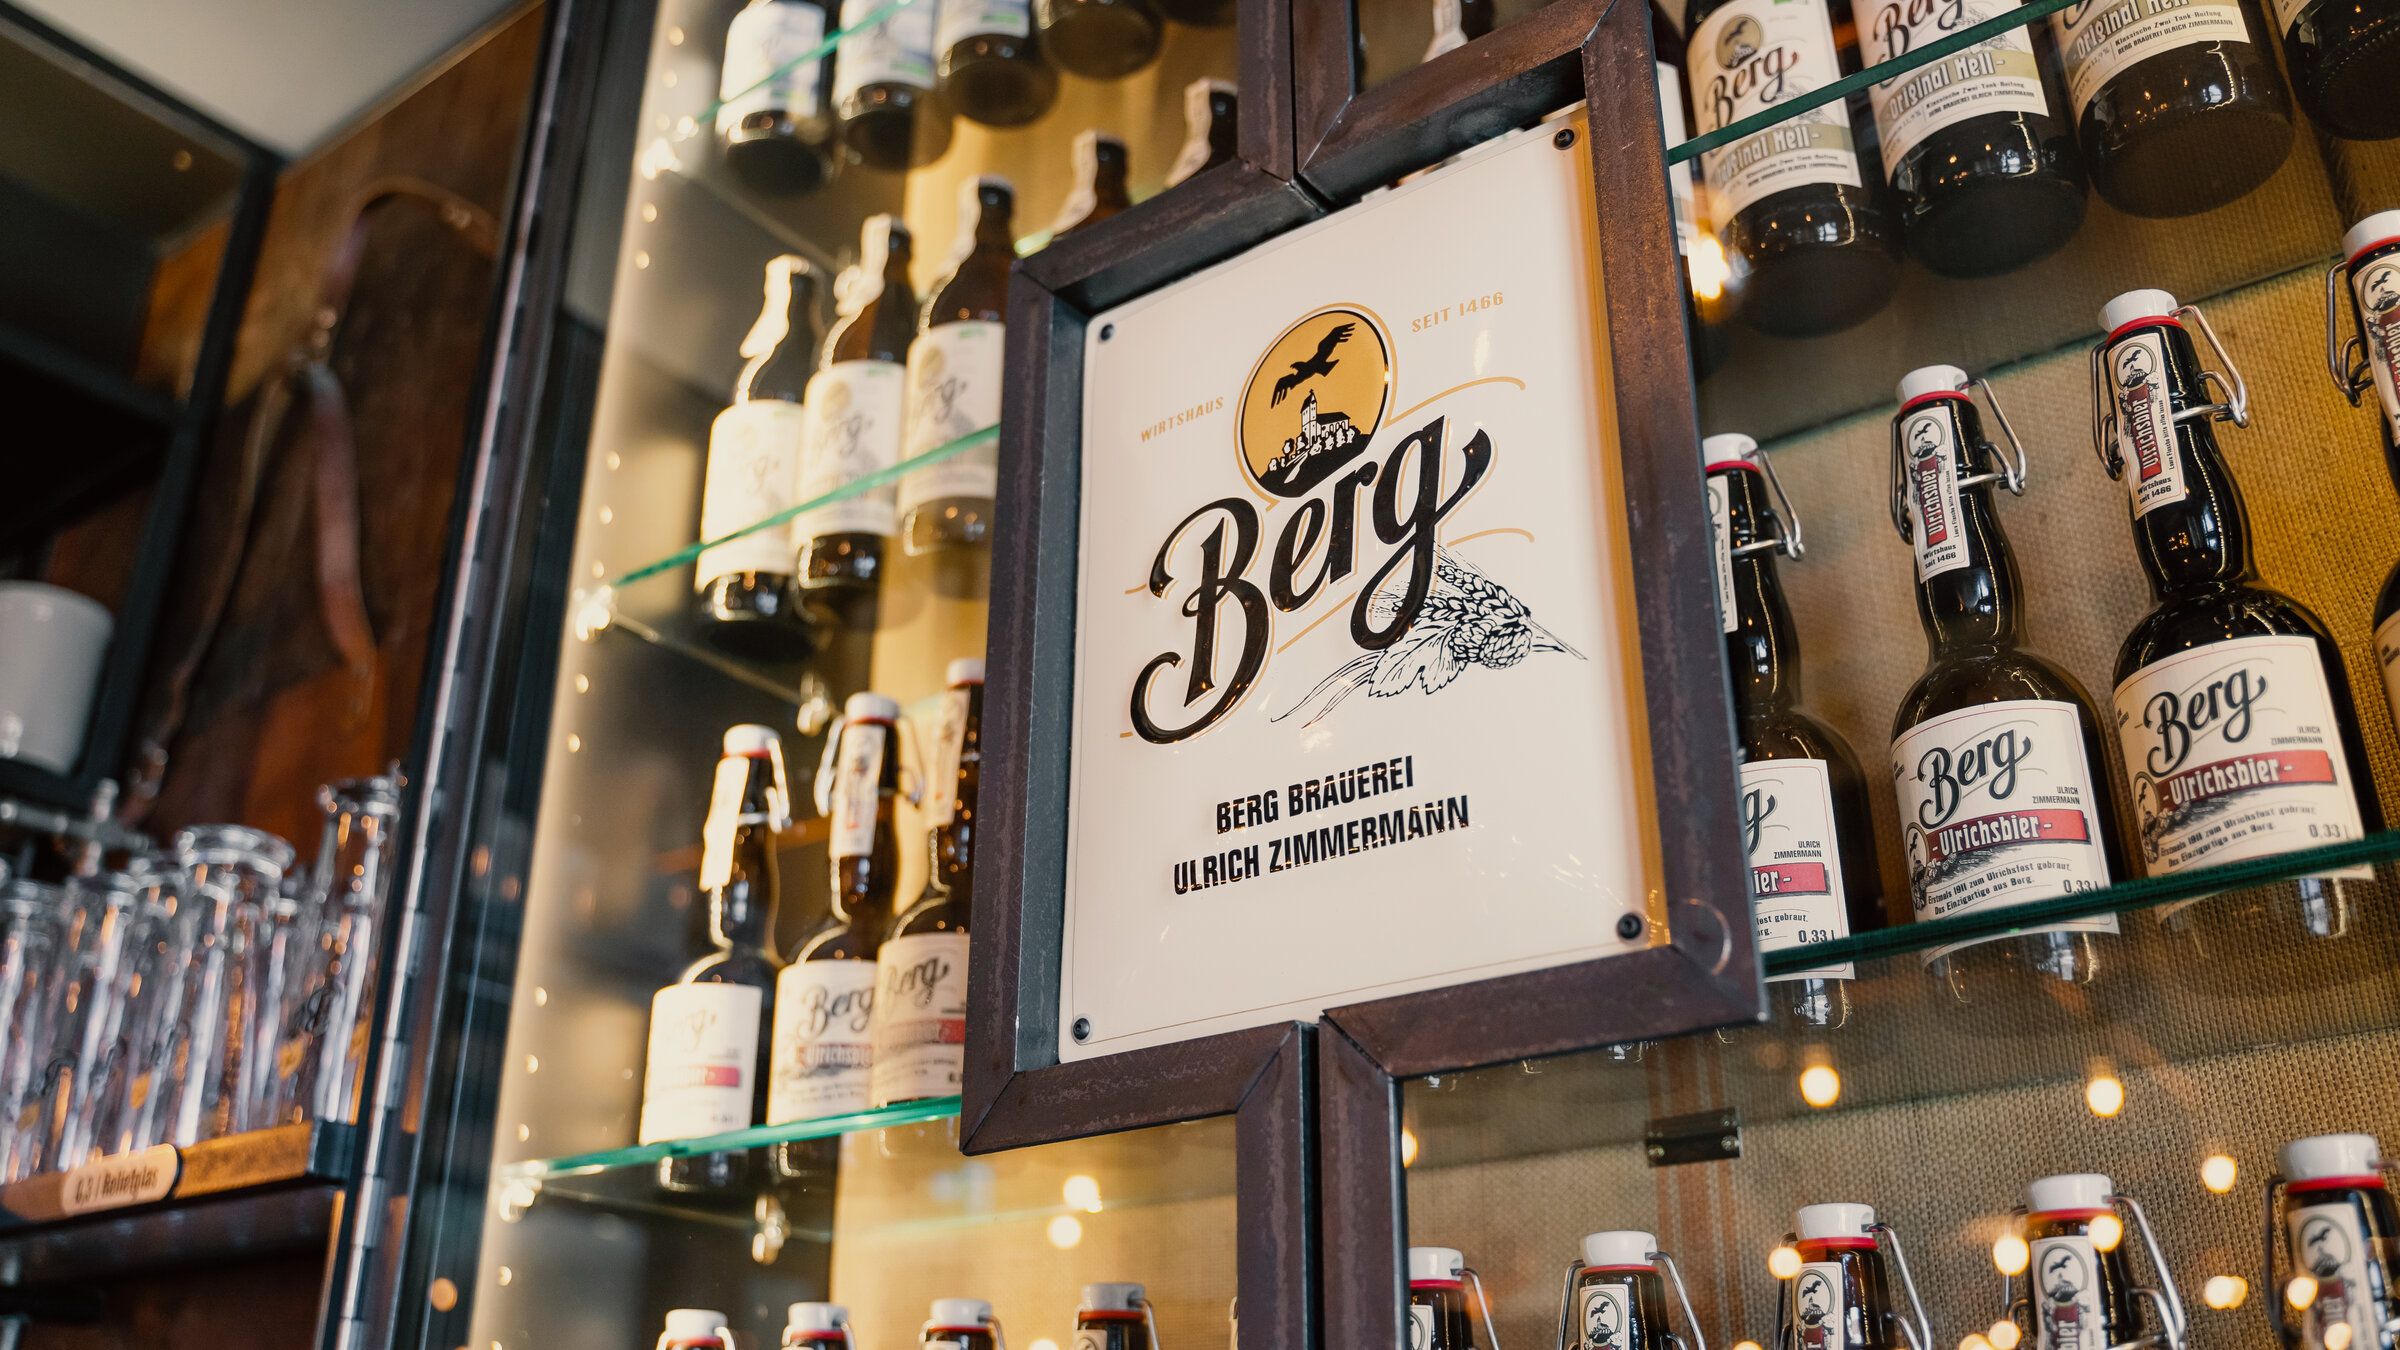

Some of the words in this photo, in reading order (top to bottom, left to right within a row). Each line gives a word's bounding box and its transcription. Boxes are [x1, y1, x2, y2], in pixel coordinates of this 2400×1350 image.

[2133, 30, 2163, 46] BRAUEREI
[2164, 23, 2187, 34] ULRICH
[2188, 19, 2233, 29] ZIMMERMANN
[1704, 46, 1799, 158] Berg
[1411, 307, 1451, 333] SEIT
[1459, 291, 1504, 316] 1466
[1140, 396, 1224, 444] WIRTSHAUS
[2132, 397, 2158, 470] Ulrichsbier
[2137, 477, 2172, 495] Wirtshaus
[1922, 467, 1945, 537] Ulrichsbier
[1923, 545, 1956, 560] Wirtshaus
[1937, 552, 1956, 562] 1466
[1130, 415, 1494, 745] Berg
[2143, 668, 2267, 778] Berg
[2271, 736, 2323, 745] ZIMMERMANN
[1917, 729, 2032, 829] Berg
[2057, 786, 2079, 795] ULRICH
[1217, 790, 1279, 835] BERG
[1288, 755, 1414, 817] BRAUEREI
[2032, 795, 2080, 805] ZIMMERMANN
[1174, 844, 1260, 895] ULRICH
[1268, 795, 1470, 874] ZIMMERMANN
[1798, 840, 1821, 849] ULRICH
[2205, 824, 2222, 837] zum
[1774, 850, 1822, 860] ZIMMERMANN
[1954, 885, 1967, 896] 1911
[1969, 878, 1985, 888] zum
[1986, 862, 2034, 881] Ulrichsfest
[1947, 887, 1991, 911] Einzigartige
[1993, 882, 2008, 892] aus
[1798, 930, 1828, 944] 0,33
